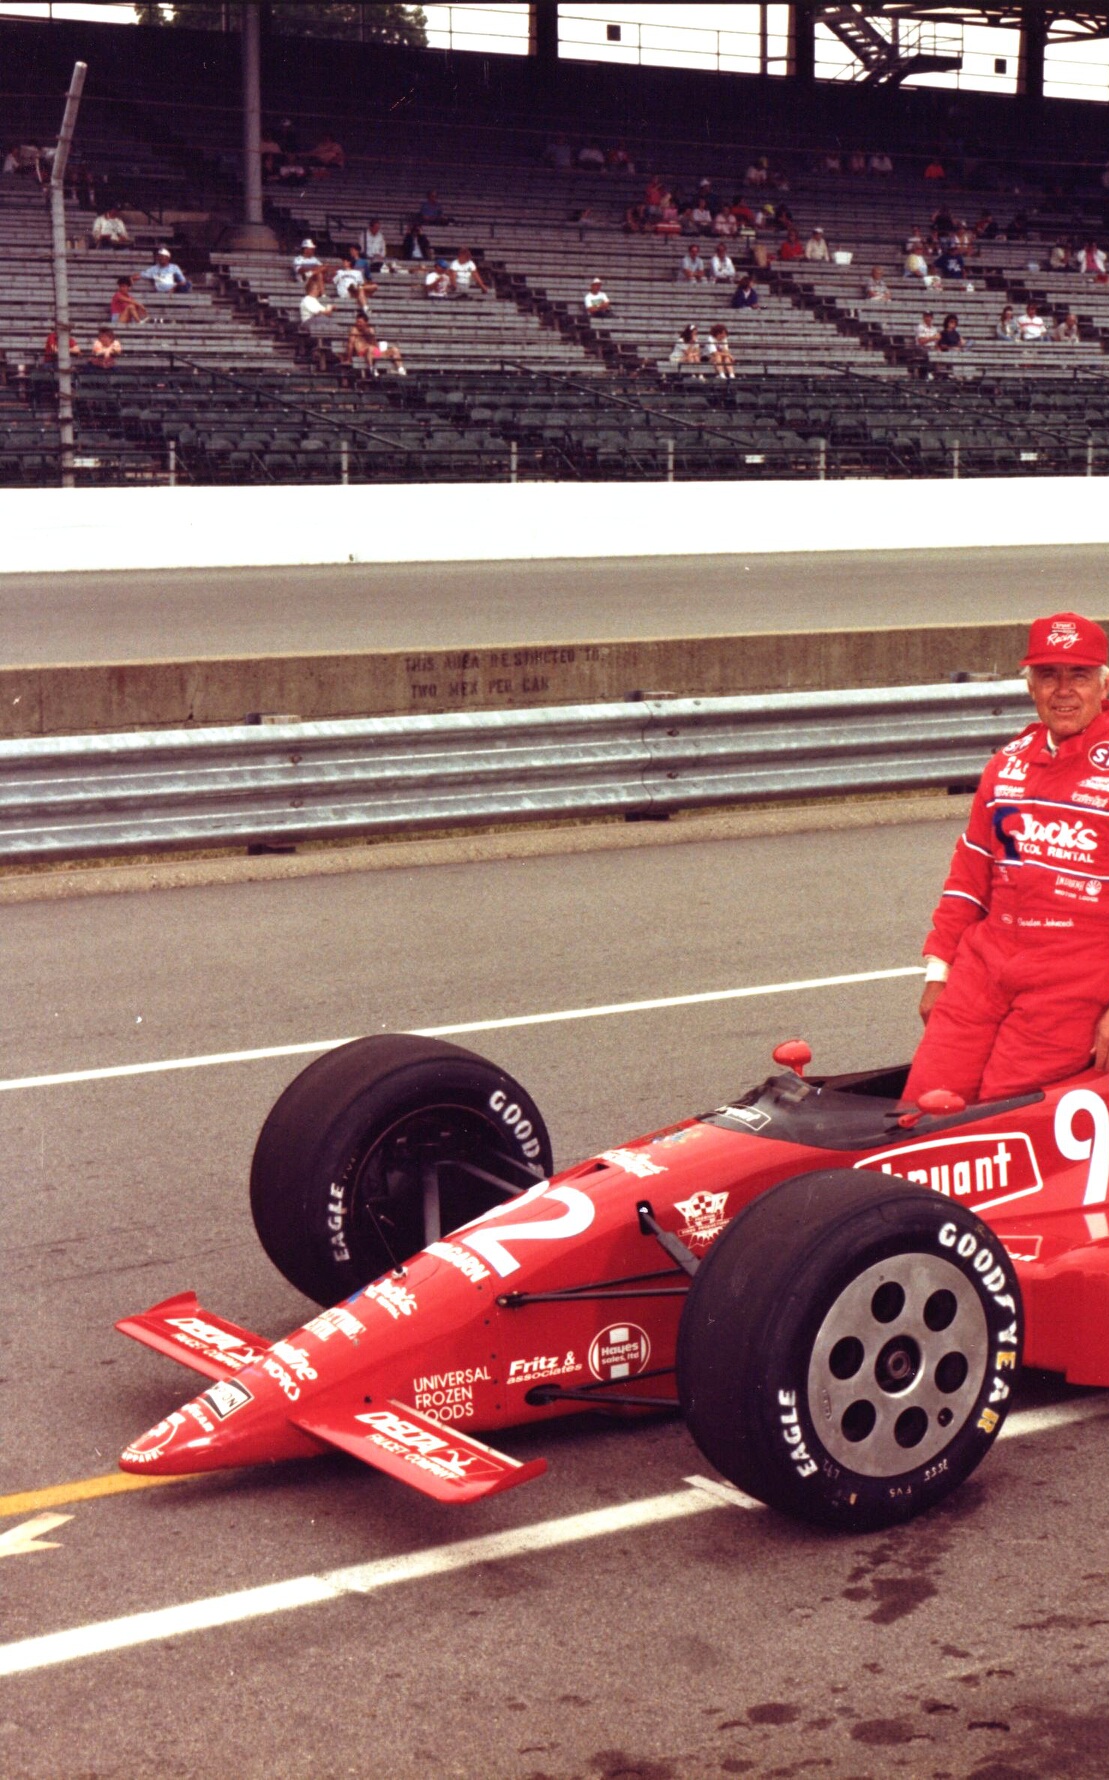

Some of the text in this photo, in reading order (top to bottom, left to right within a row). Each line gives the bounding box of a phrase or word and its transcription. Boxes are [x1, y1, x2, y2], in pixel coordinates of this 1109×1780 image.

[405, 656, 434, 673] THIS
[410, 683, 437, 699] TWO
[489, 679, 514, 694] PER
[1009, 813, 1098, 851] Jack's
[1018, 842, 1095, 864] TOOL RENTAL
[881, 1141, 1012, 1199] ryant
[327, 1181, 351, 1263] EAGLE
[164, 1317, 247, 1351] DELTA
[601, 1341, 639, 1357] Hayes
[506, 1362, 583, 1386] associates
[509, 1351, 577, 1377] Fritz &
[413, 1365, 491, 1393] UNIVERSAL
[415, 1385, 473, 1409] FROZEN
[419, 1401, 475, 1421] OODS
[354, 1411, 450, 1451] DELTA
[778, 1389, 819, 1478] EAGLE
[366, 1434, 410, 1457] FAUCET
